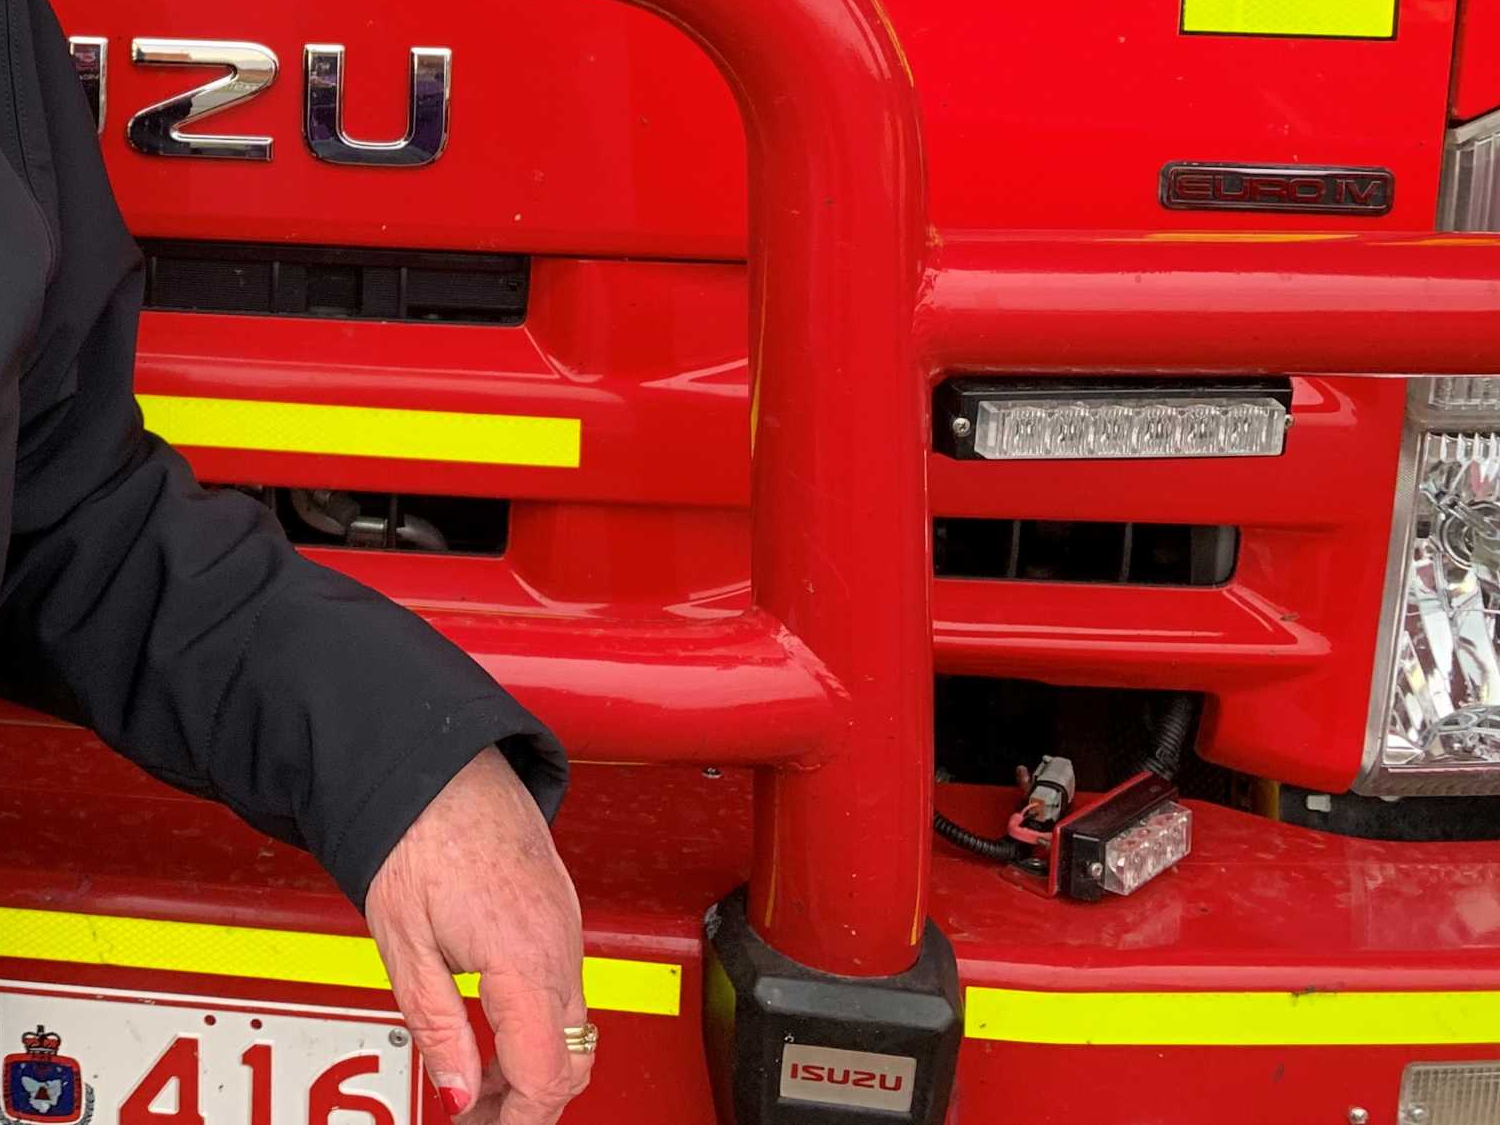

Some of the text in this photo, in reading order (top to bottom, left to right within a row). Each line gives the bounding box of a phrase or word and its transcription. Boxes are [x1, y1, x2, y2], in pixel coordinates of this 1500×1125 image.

[1175, 174, 1382, 205] EURO IV
[789, 1063, 903, 1092] ISUZU
